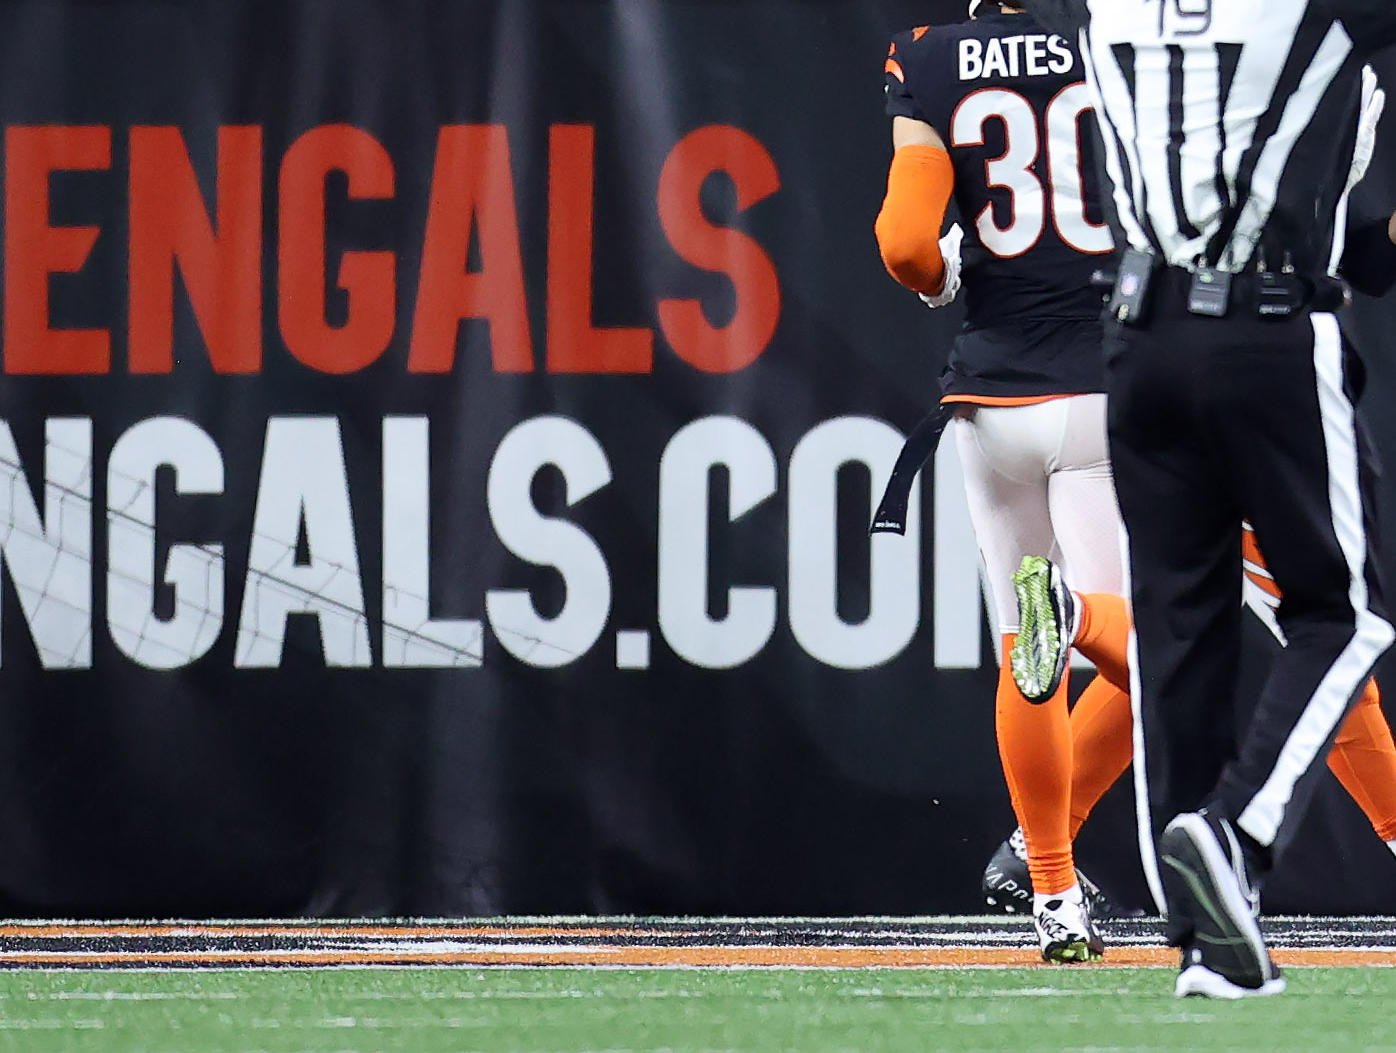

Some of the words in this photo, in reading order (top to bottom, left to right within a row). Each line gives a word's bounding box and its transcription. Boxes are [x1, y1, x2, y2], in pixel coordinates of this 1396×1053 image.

[959, 35, 1073, 80] BATES
[951, 81, 1115, 258] 30
[3, 124, 781, 375] ENGALS
[984, 863, 1034, 902] VAPO
